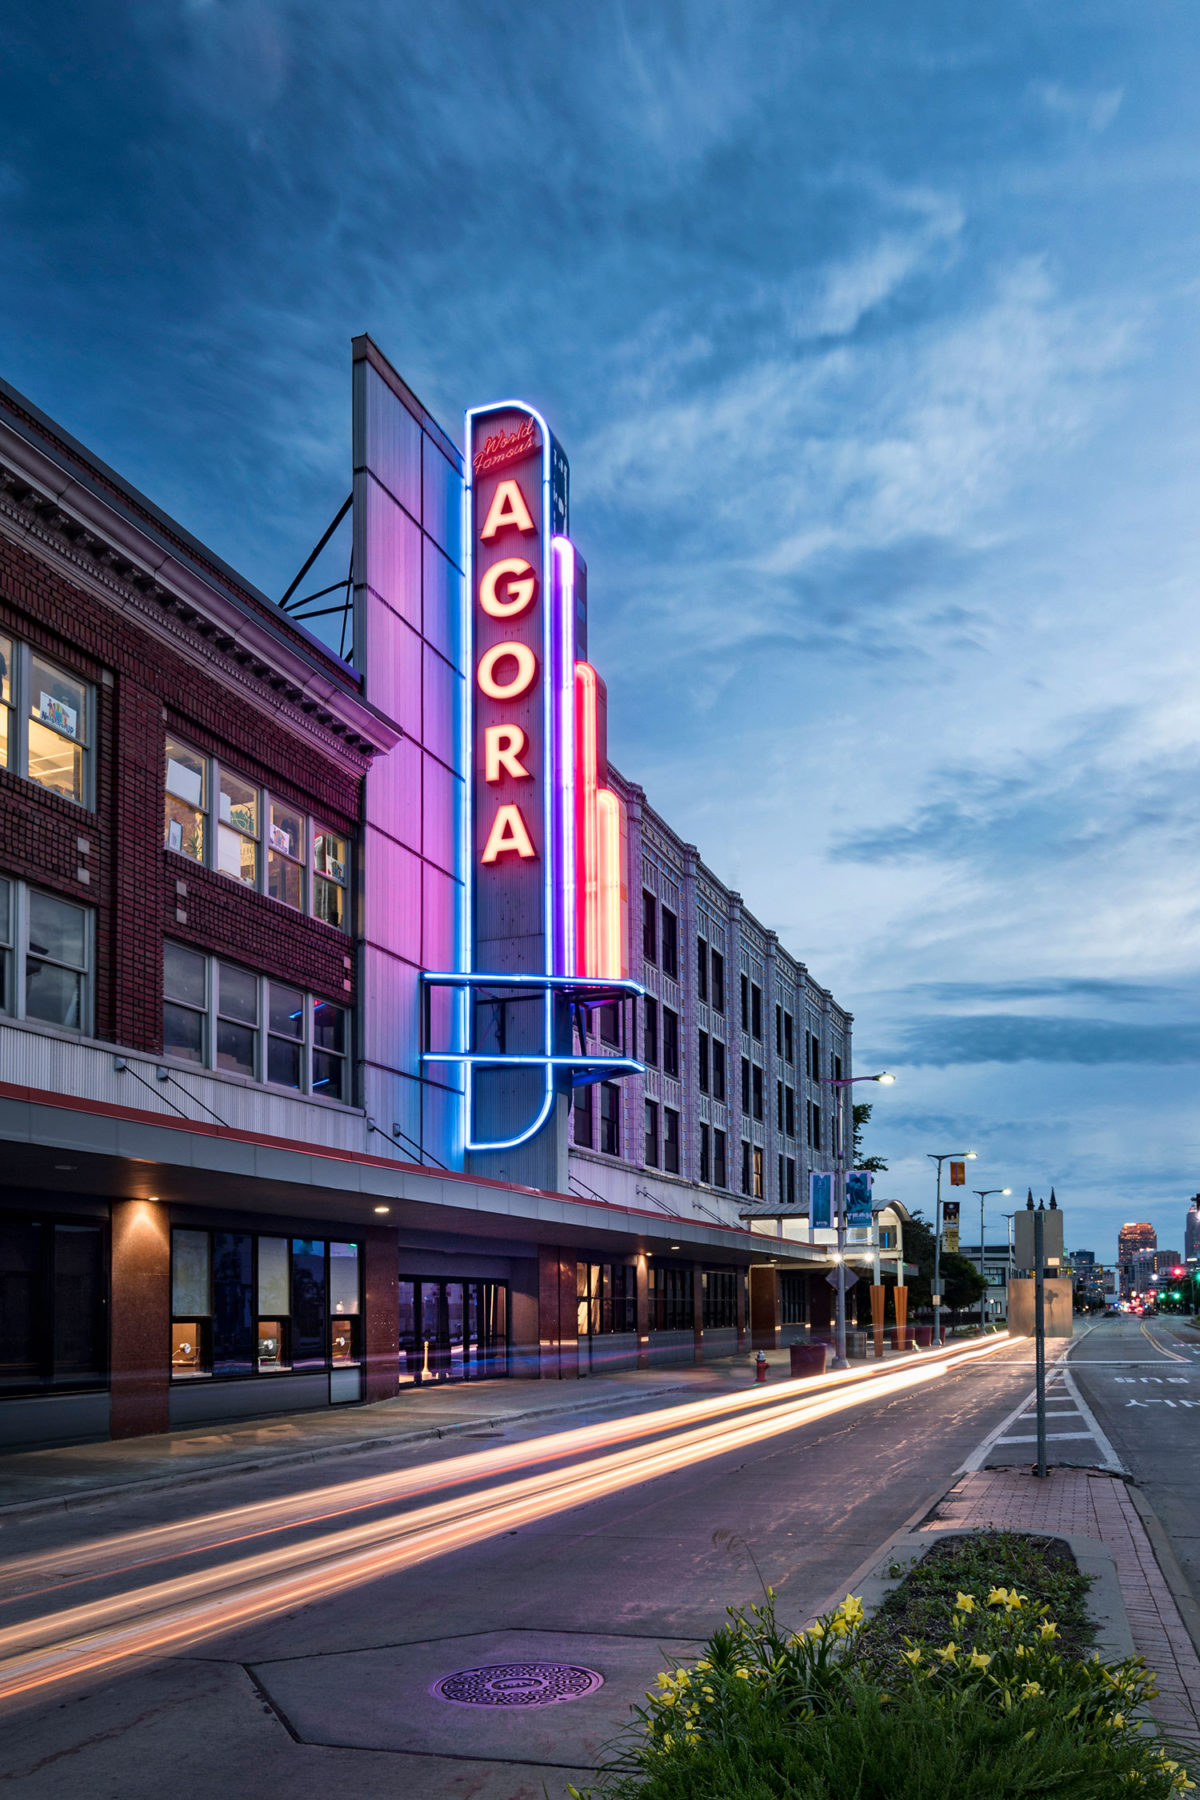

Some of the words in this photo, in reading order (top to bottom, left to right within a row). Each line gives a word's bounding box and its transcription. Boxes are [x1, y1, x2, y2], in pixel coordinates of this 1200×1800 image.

[484, 417, 533, 454] World
[472, 436, 532, 474] Famous
[477, 478, 539, 866] AGORA
